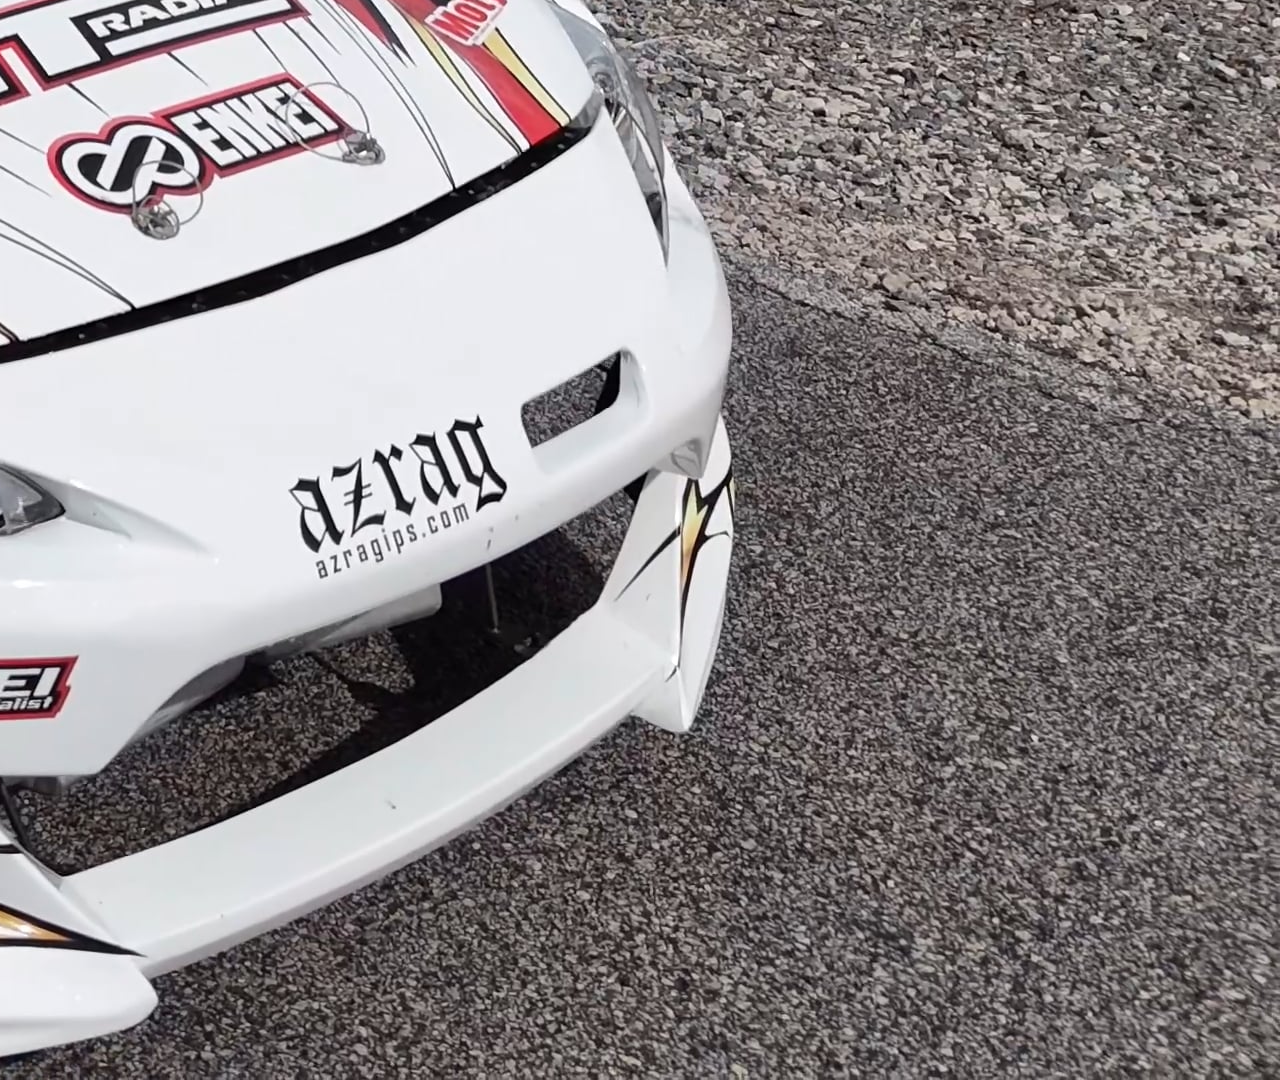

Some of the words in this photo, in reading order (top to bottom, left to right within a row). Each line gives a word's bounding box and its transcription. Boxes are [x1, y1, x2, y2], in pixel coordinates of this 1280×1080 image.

[170, 81, 339, 167] ENKEI
[289, 414, 507, 553] azrag
[315, 502, 471, 580] azragips.com
